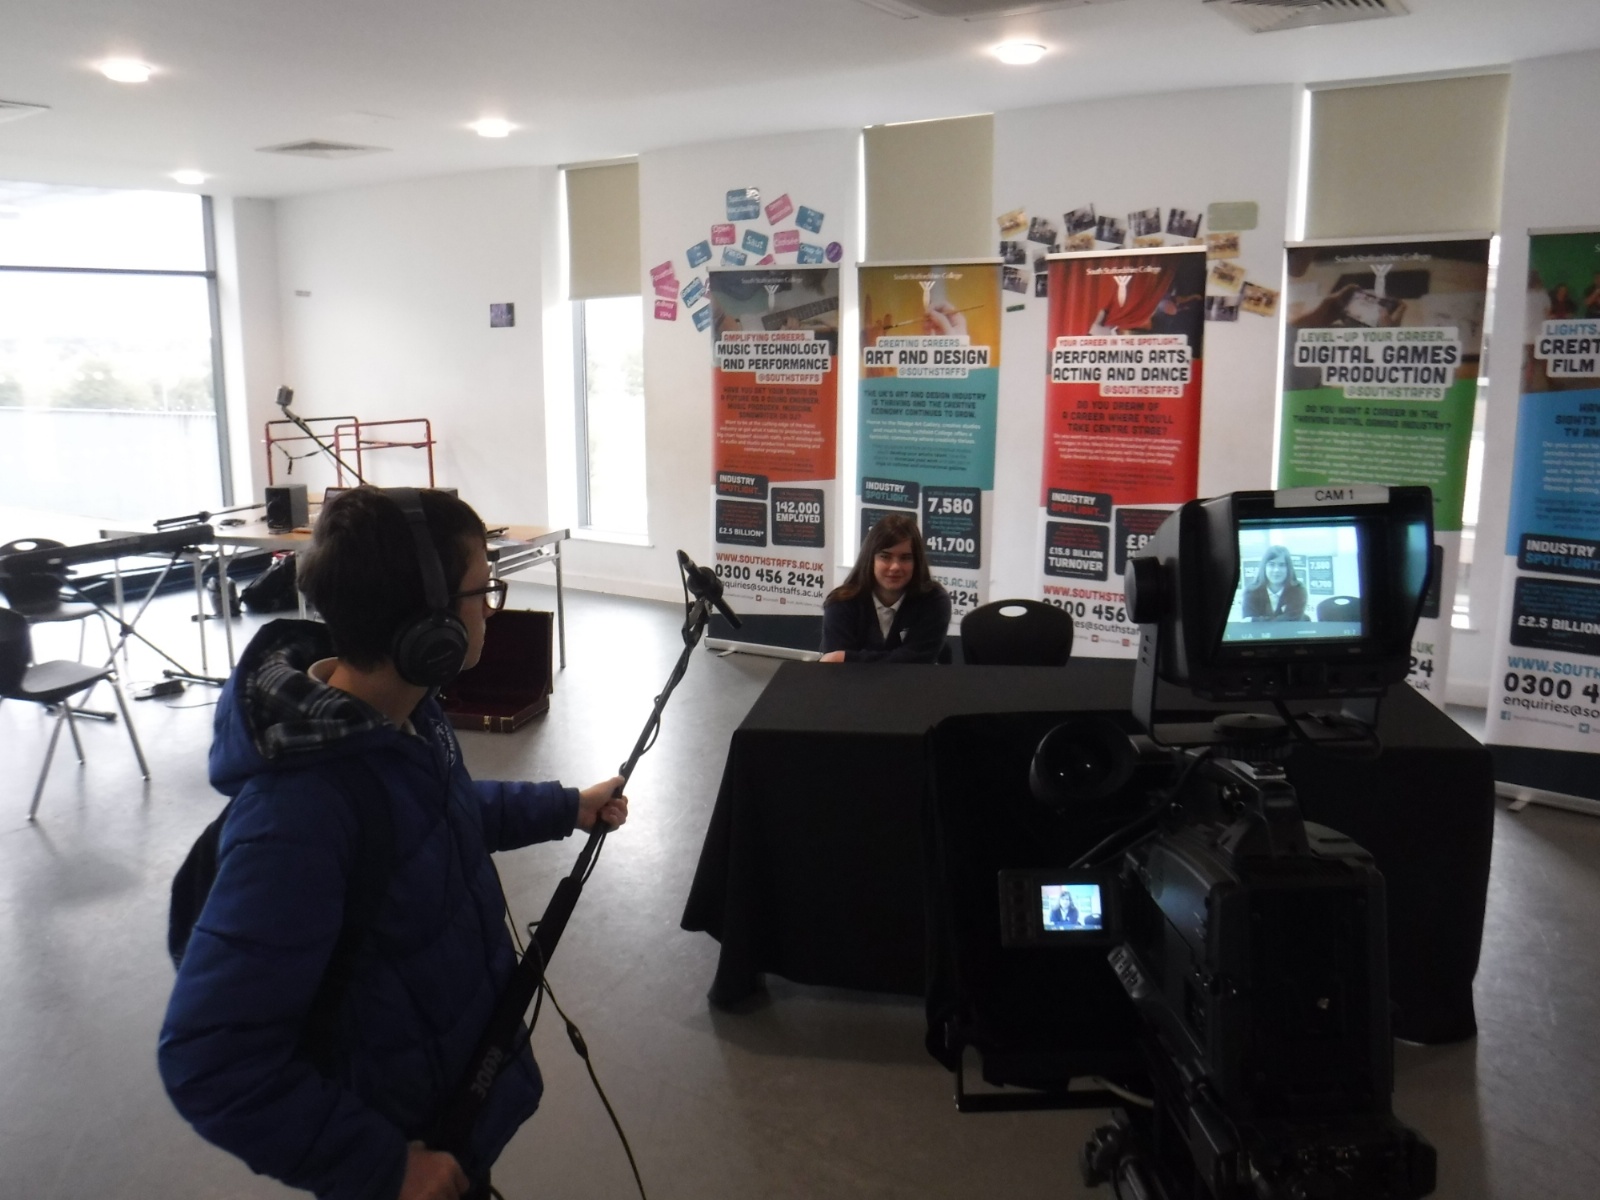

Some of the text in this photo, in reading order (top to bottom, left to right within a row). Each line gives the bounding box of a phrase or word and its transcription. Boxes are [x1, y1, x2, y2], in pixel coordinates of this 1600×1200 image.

[1060, 338, 1078, 346] YOUR
[1080, 338, 1108, 346] CAREER
[1110, 338, 1118, 346] IN
[1121, 338, 1134, 346] THE
[1301, 332, 1358, 342] LEVEL-UP
[1363, 332, 1392, 342] YOUR
[718, 344, 826, 355] MUSIC TECHNOLOGY
[878, 340, 919, 348] CREATING
[1540, 338, 1600, 354] CREAT
[866, 350, 988, 364] ART AND DESIGN
[1055, 350, 1143, 364] PERFORMING
[1299, 346, 1457, 364] DIGITAL GAMES
[723, 358, 828, 370] AND PERFORMANCE
[1552, 358, 1594, 372] FILM
[759, 374, 820, 382] @SOUTHSTAFFS
[899, 368, 966, 376] @SOUTHSTAFFS
[1054, 368, 1188, 382] ACTING AND DANCE
[1326, 366, 1446, 384] PRODUCTION
[1104, 386, 1180, 395] @SOUTHSTAFFS
[1348, 386, 1441, 398] @SOUTHSTAFFS
[944, 402, 976, 410] CREATIVE
[1092, 402, 1109, 410] YOU
[1113, 402, 1144, 410] DREAM
[1148, 402, 1160, 411] OF
[1072, 412, 1104, 420] CAREER
[1108, 413, 1139, 422] WHERE
[1144, 414, 1174, 424] YOU'LL
[1373, 408, 1406, 416] CAREER
[1422, 410, 1438, 418] THE
[1068, 423, 1168, 436] TAKE CENTRE STAGE?
[720, 474, 755, 486] INDUSTRY
[866, 482, 905, 492] INDUSTRY
[1052, 493, 1096, 506] INDUSTRY
[1315, 489, 1354, 501] CAM 1
[776, 502, 820, 514] 142,000
[928, 498, 973, 514] 7,580
[776, 514, 820, 524] EMPLOYED
[926, 536, 975, 552] 41,700
[1526, 540, 1596, 557] INDUSTRY
[1072, 548, 1104, 559] BILLION
[716, 553, 824, 572] WWW.SOUTHSTAFFS.AC.UK
[1048, 557, 1103, 572] TURNOVER
[715, 564, 824, 588] 0300 456 2424
[724, 582, 824, 598] quiries@southstaffs.ac.uk
[1044, 585, 1126, 603] WWW.SOUTHSTA
[949, 590, 978, 607] 424
[1043, 598, 1126, 622] 00 456
[1518, 616, 1548, 629] £2.5
[1504, 672, 1572, 700] 0300
